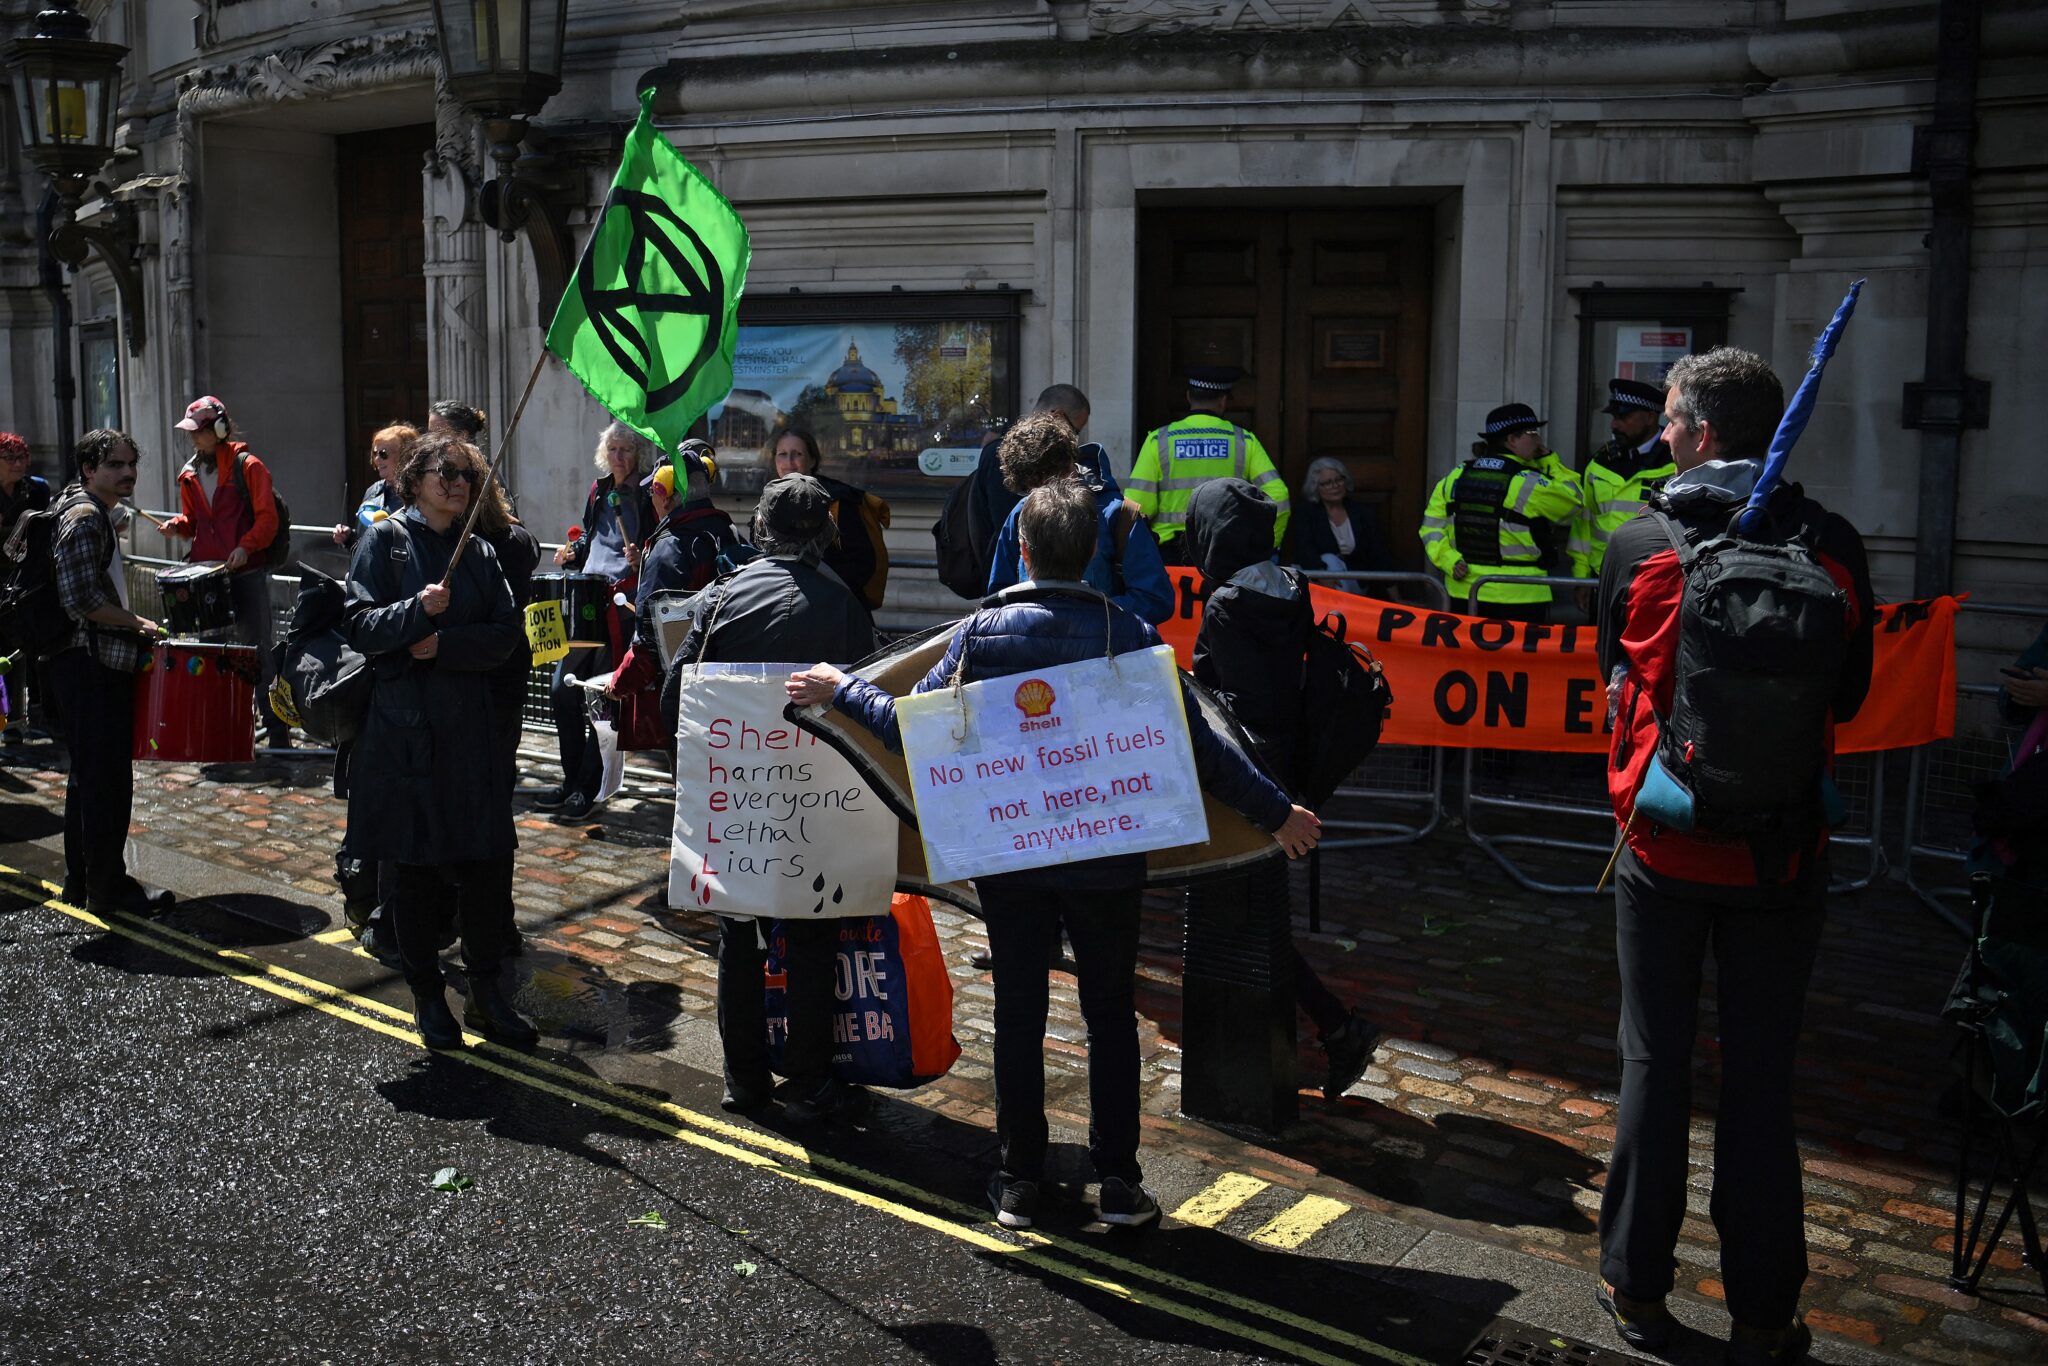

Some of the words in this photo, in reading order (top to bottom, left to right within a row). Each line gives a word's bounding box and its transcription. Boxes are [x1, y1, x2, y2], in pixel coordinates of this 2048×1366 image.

[772, 346, 792, 356] YOU
[782, 355, 806, 365] HALL
[734, 365, 788, 375] ESTMINSTER
[1176, 445, 1227, 458] POLICE
[1475, 457, 1503, 469] POLICE
[529, 607, 556, 627] LOVE
[1377, 607, 1597, 653] PROFI
[538, 627, 547, 638] IS
[531, 638, 561, 654] ACTION
[1433, 670, 1529, 728] ON
[1019, 716, 1061, 732] Shell
[929, 765, 963, 786] No
[975, 754, 1025, 779] new
[1036, 735, 1099, 769] fossil
[1105, 725, 1165, 755] fuels
[709, 756, 813, 784] harms
[709, 787, 865, 821] everyone
[988, 798, 1030, 823] not
[1042, 786, 1107, 812] here,
[1111, 772, 1153, 796] not
[707, 817, 812, 844] Lethal
[1012, 813, 1140, 851] anywhere.
[701, 851, 807, 877] Liars
[834, 950, 888, 1001] ORE
[833, 1012, 861, 1043] HE
